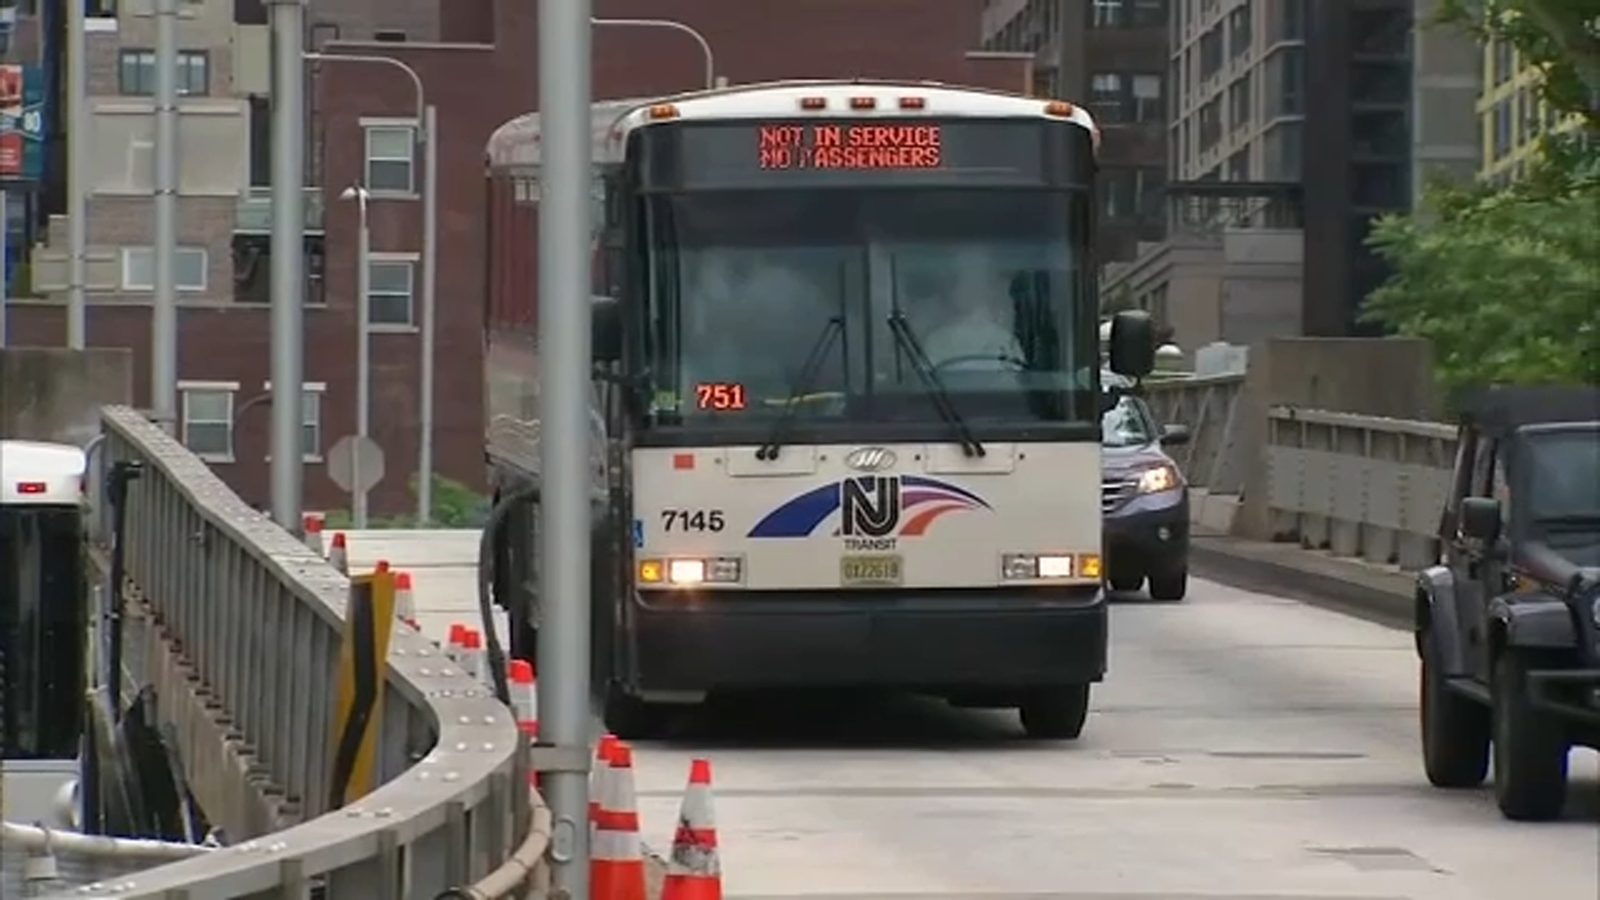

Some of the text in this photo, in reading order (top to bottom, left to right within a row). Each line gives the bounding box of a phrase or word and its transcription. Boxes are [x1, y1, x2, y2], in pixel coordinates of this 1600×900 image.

[759, 126, 941, 147] NOT IN SERVICE
[759, 147, 791, 168] NO
[697, 384, 744, 408] 751
[842, 476, 899, 537] NJ
[661, 509, 725, 532] 7145
[844, 538, 897, 550] TRANSIT
